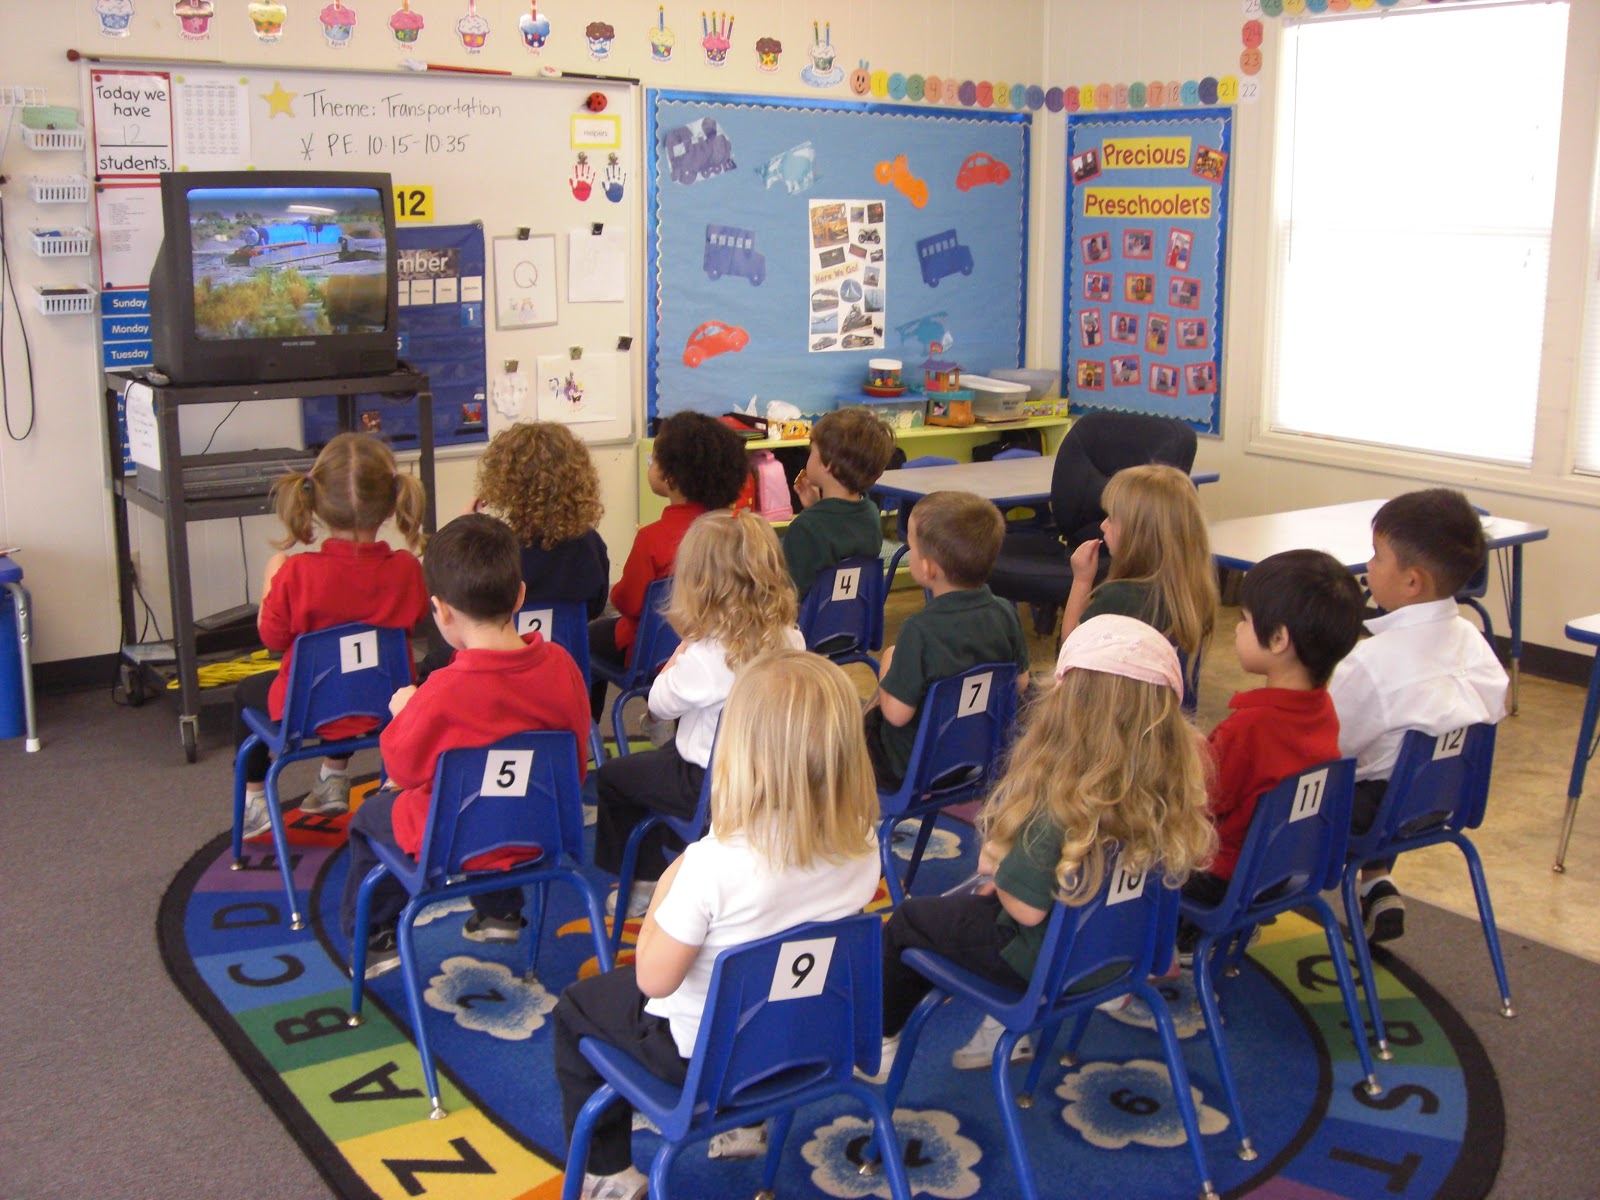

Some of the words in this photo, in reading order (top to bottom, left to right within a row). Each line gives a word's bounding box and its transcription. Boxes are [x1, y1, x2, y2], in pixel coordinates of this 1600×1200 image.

[181, 31, 209, 40] February
[259, 36, 279, 44] March
[1246, 26, 1262, 42] 24
[401, 43, 413, 51] May
[1244, 53, 1259, 67] 23
[96, 86, 141, 102] Today
[144, 90, 167, 102] we
[894, 78, 902, 94] 2
[912, 79, 920, 96] 3
[929, 82, 938, 98] 4
[946, 82, 955, 99] 5
[982, 86, 991, 99] 7
[998, 86, 1007, 104] 8
[1014, 86, 1022, 100] 9
[1082, 89, 1093, 105] 13
[1114, 88, 1126, 105] 15
[1131, 86, 1143, 104] 16
[1149, 87, 1162, 102] 17
[1168, 87, 1179, 102] 18
[1186, 88, 1197, 103] 19
[1222, 82, 1236, 97] 21
[1242, 84, 1258, 98] 22
[113, 103, 151, 117] have
[304, 88, 376, 118] Theme:
[381, 93, 501, 122] Transportation
[122, 124, 145, 146] 12
[99, 155, 171, 171] students.
[1103, 143, 1186, 165] Precious
[397, 190, 426, 216] 12
[1085, 194, 1211, 215] Preschoolers
[513, 261, 538, 288] Q
[815, 273, 832, 284] Here
[834, 268, 844, 278] We
[845, 263, 859, 273] Go!
[112, 299, 147, 309] Sunday
[468, 307, 474, 321] 1
[112, 324, 149, 334] Monday
[111, 349, 149, 360] Tuesday
[841, 575, 851, 595] 4
[353, 642, 362, 664] 1
[968, 682, 982, 709] 7
[1440, 728, 1465, 751] 12
[496, 760, 516, 788] 5
[1300, 780, 1322, 812] 11
[212, 901, 281, 931] D
[227, 954, 304, 988] C
[791, 952, 815, 990] 9
[274, 1006, 355, 1045] B
[329, 1061, 425, 1103] A
[1352, 1079, 1439, 1115] S
[381, 1137, 496, 1197] Z
[1329, 1147, 1422, 1193] T
